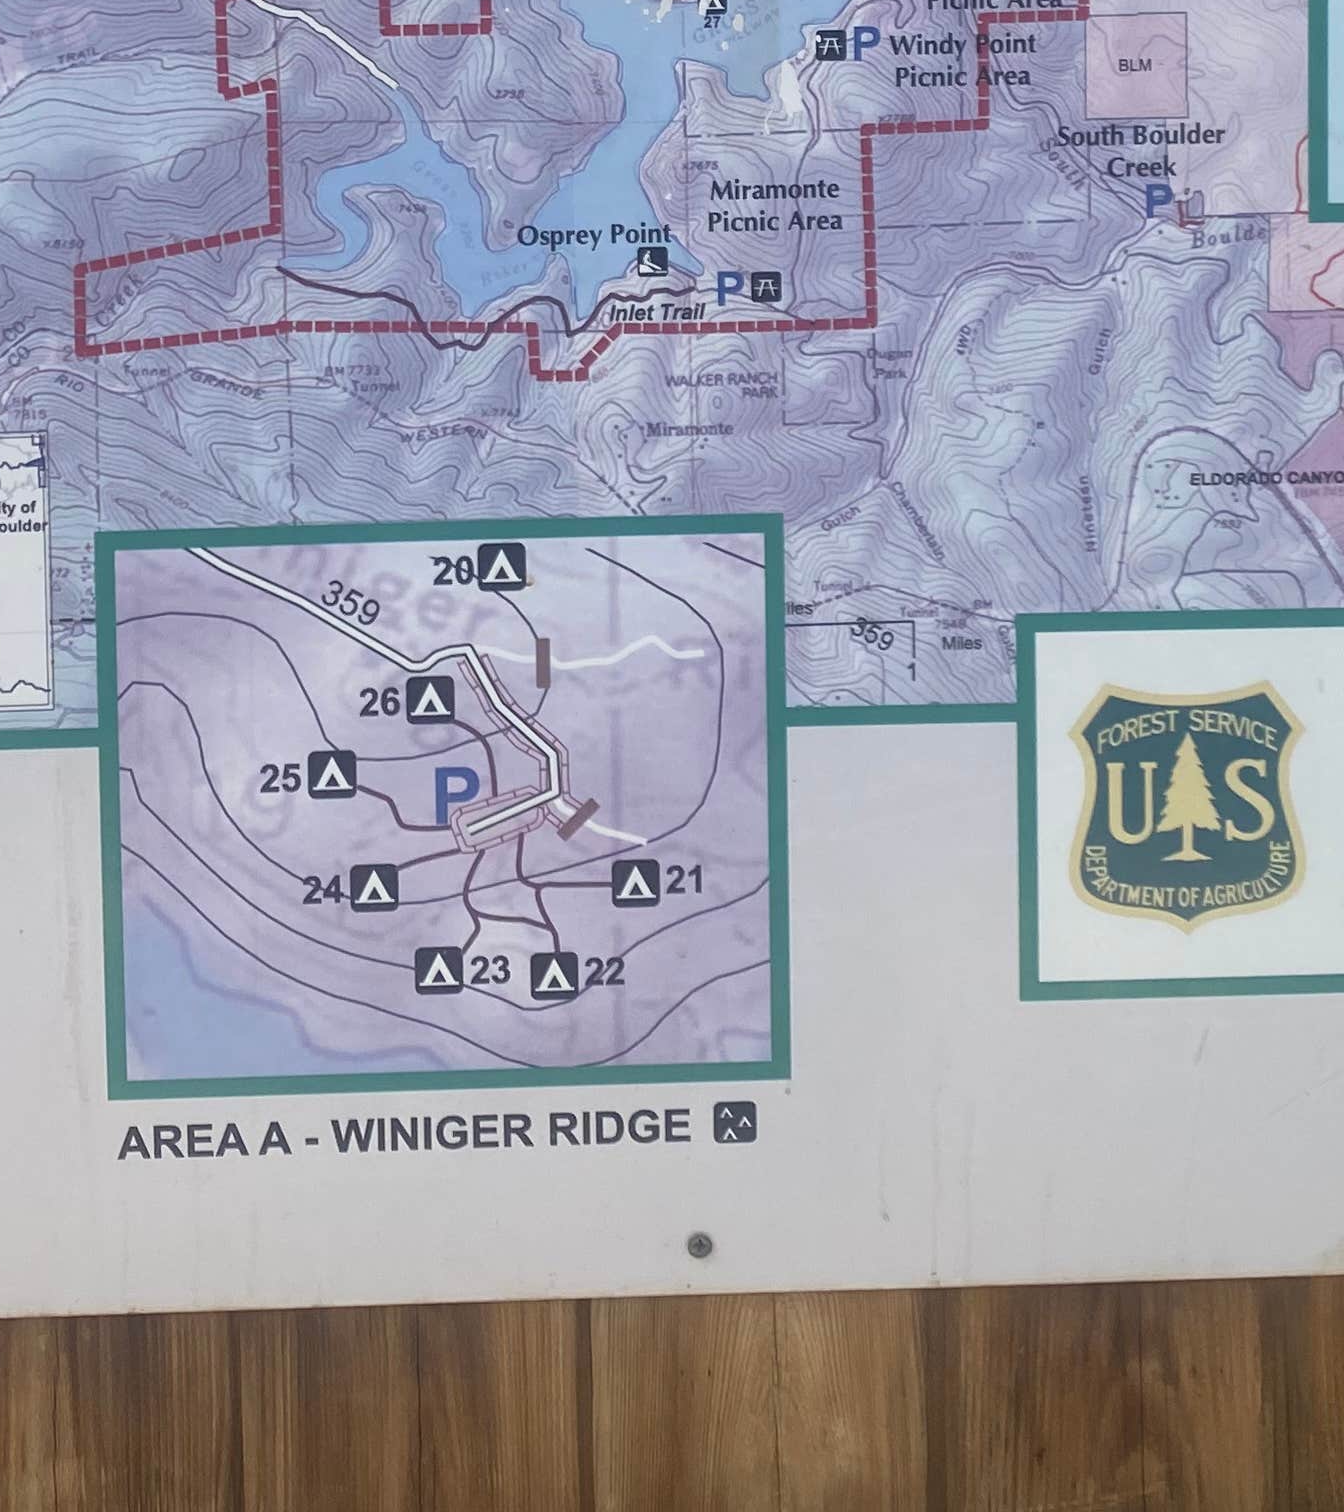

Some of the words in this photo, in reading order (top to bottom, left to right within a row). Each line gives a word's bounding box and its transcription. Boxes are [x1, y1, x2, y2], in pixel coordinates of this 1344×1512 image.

[1119, 59, 1151, 72] BLM
[517, 223, 607, 251] Osprey
[611, 223, 674, 247] Point
[609, 303, 656, 324] Inlet
[661, 301, 706, 323] Trail
[21, 500, 36, 513] of
[320, 580, 382, 626] 359
[360, 687, 400, 717] 26
[1097, 708, 1180, 753] FOREST
[1188, 708, 1280, 753] SERVICE
[260, 764, 301, 793] 25
[667, 865, 701, 894] 21
[471, 956, 511, 985] 23
[584, 957, 626, 986] 22
[118, 1123, 249, 1159] AREA
[259, 1122, 291, 1155] A
[331, 1114, 533, 1152] WINIGER
[550, 1109, 691, 1146] RIDGE
